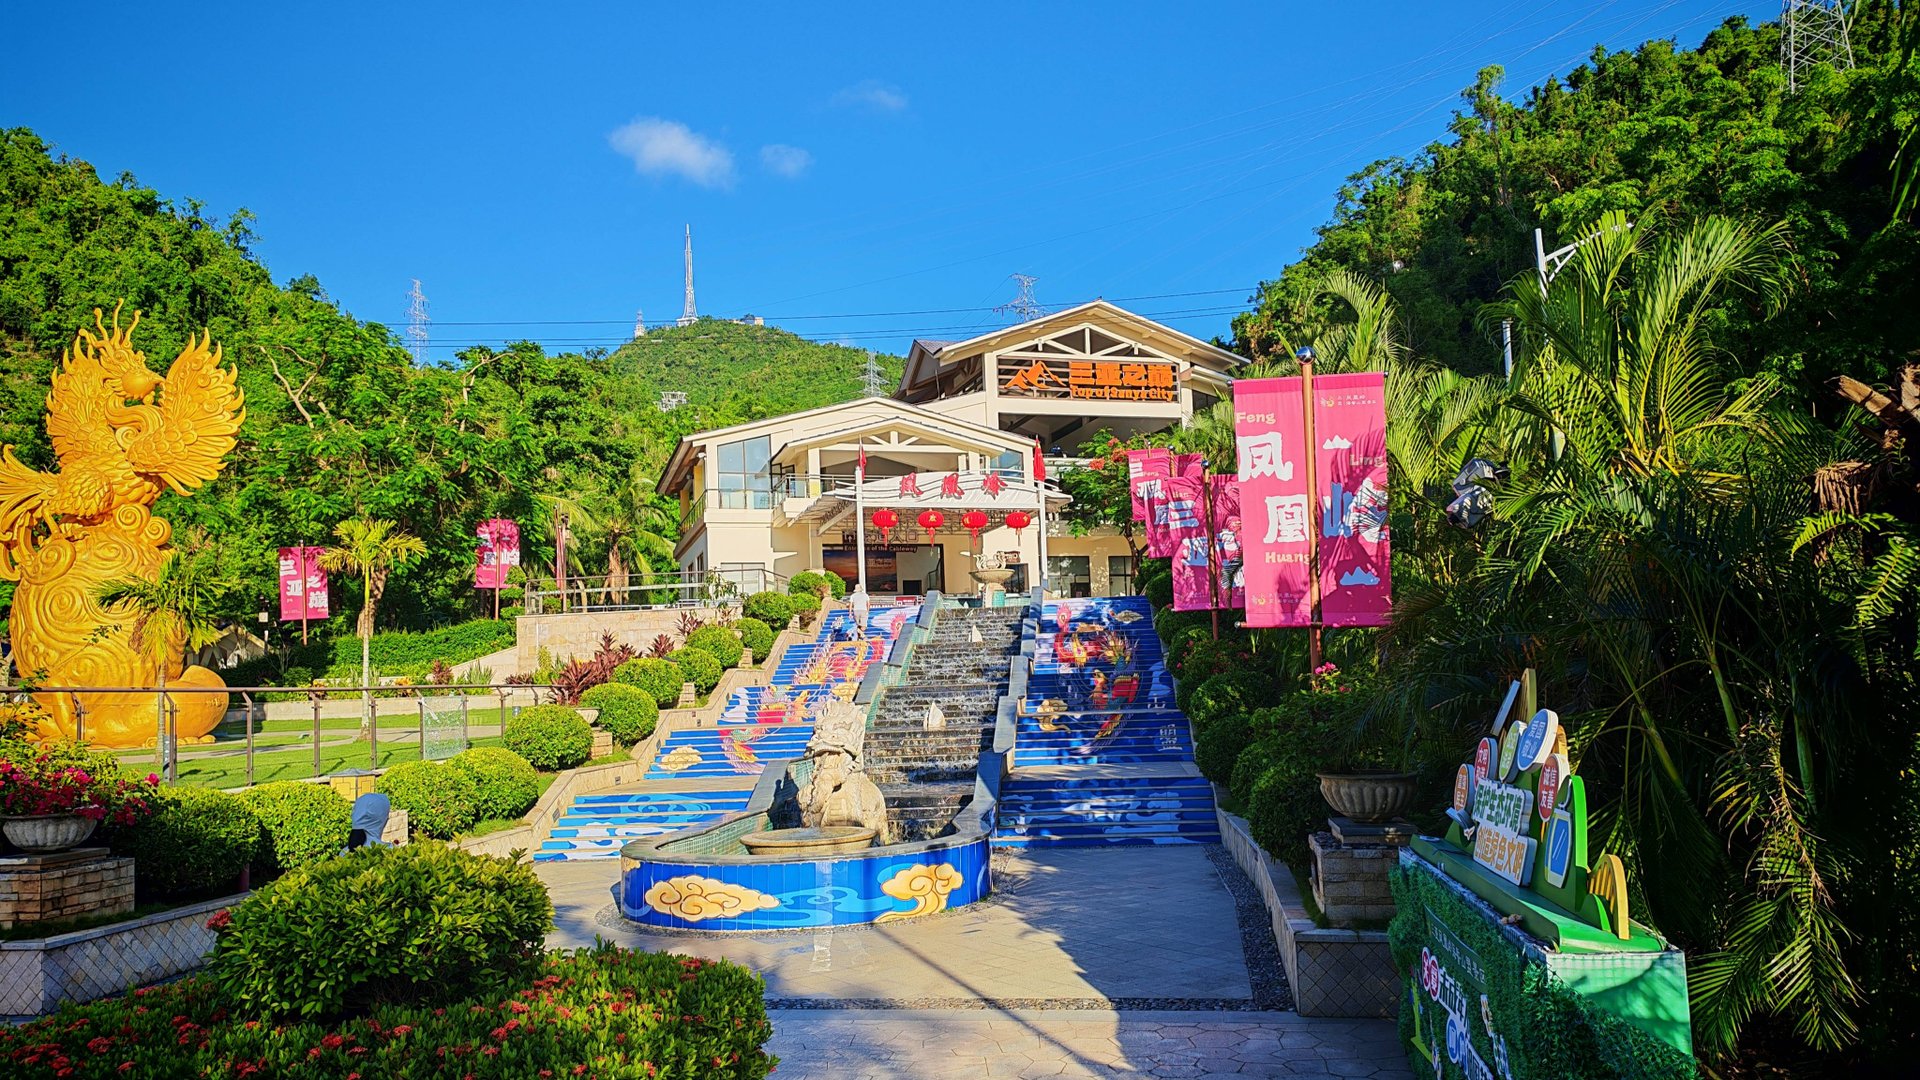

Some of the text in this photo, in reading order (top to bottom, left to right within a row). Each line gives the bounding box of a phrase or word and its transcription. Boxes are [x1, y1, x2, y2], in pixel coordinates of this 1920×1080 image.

[1069, 362, 1174, 388] 三亚之巅
[1071, 386, 1093, 400] Top
[1096, 385, 1110, 400] of
[1148, 387, 1173, 402] City
[1236, 412, 1276, 424] Feng
